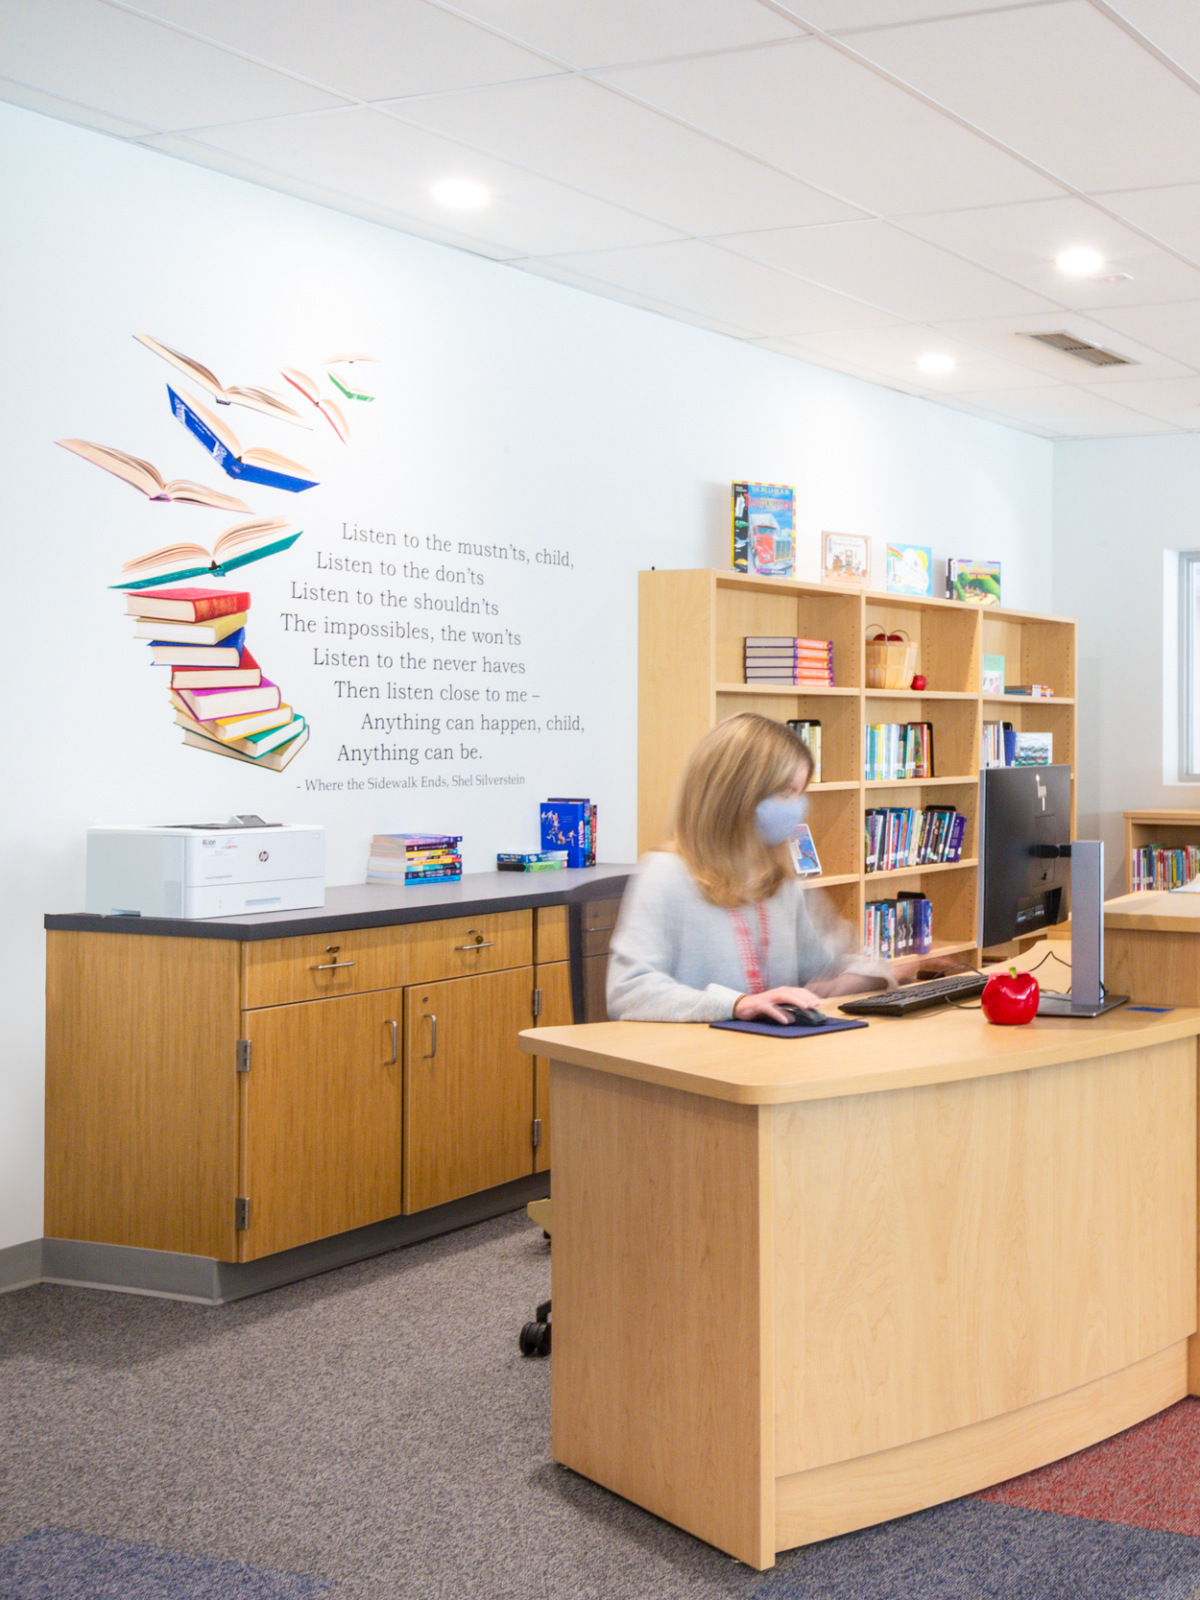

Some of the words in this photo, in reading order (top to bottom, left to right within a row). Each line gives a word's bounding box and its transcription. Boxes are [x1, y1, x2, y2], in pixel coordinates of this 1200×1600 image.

[341, 521, 397, 546] Listen
[403, 532, 420, 549] to
[425, 533, 452, 553] the
[457, 541, 530, 566] mustn'ts,
[534, 547, 574, 570] child,
[316, 550, 374, 575] Listen
[379, 559, 397, 577] to
[402, 560, 430, 580] the
[434, 564, 485, 586] don'ts
[290, 580, 350, 604] Listen
[355, 588, 374, 606] to
[379, 589, 408, 609] the
[413, 592, 500, 616] shouldn'ts
[279, 612, 317, 634] The
[323, 615, 435, 644] impossibles,
[440, 624, 467, 643] the
[471, 627, 522, 646] won'ts
[312, 647, 371, 668] Listen
[376, 652, 394, 669] to
[399, 651, 427, 671] the
[432, 658, 478, 673] never
[481, 655, 526, 675] haves
[333, 679, 381, 700] Then
[386, 681, 435, 701] listen
[439, 683, 481, 702] close
[484, 687, 501, 703] to
[505, 690, 528, 703] me
[360, 712, 442, 736] Anything
[445, 718, 475, 731] can
[480, 713, 542, 736] happen,
[545, 714, 585, 734] child,
[336, 742, 420, 767] Anything
[423, 747, 455, 761] can
[459, 742, 483, 760] be.
[304, 778, 345, 792] Where
[346, 777, 366, 791] the
[367, 775, 419, 790] Sidewalk
[420, 775, 450, 789] Ends,
[451, 774, 474, 787] Shel
[474, 773, 526, 787] Silverstein
